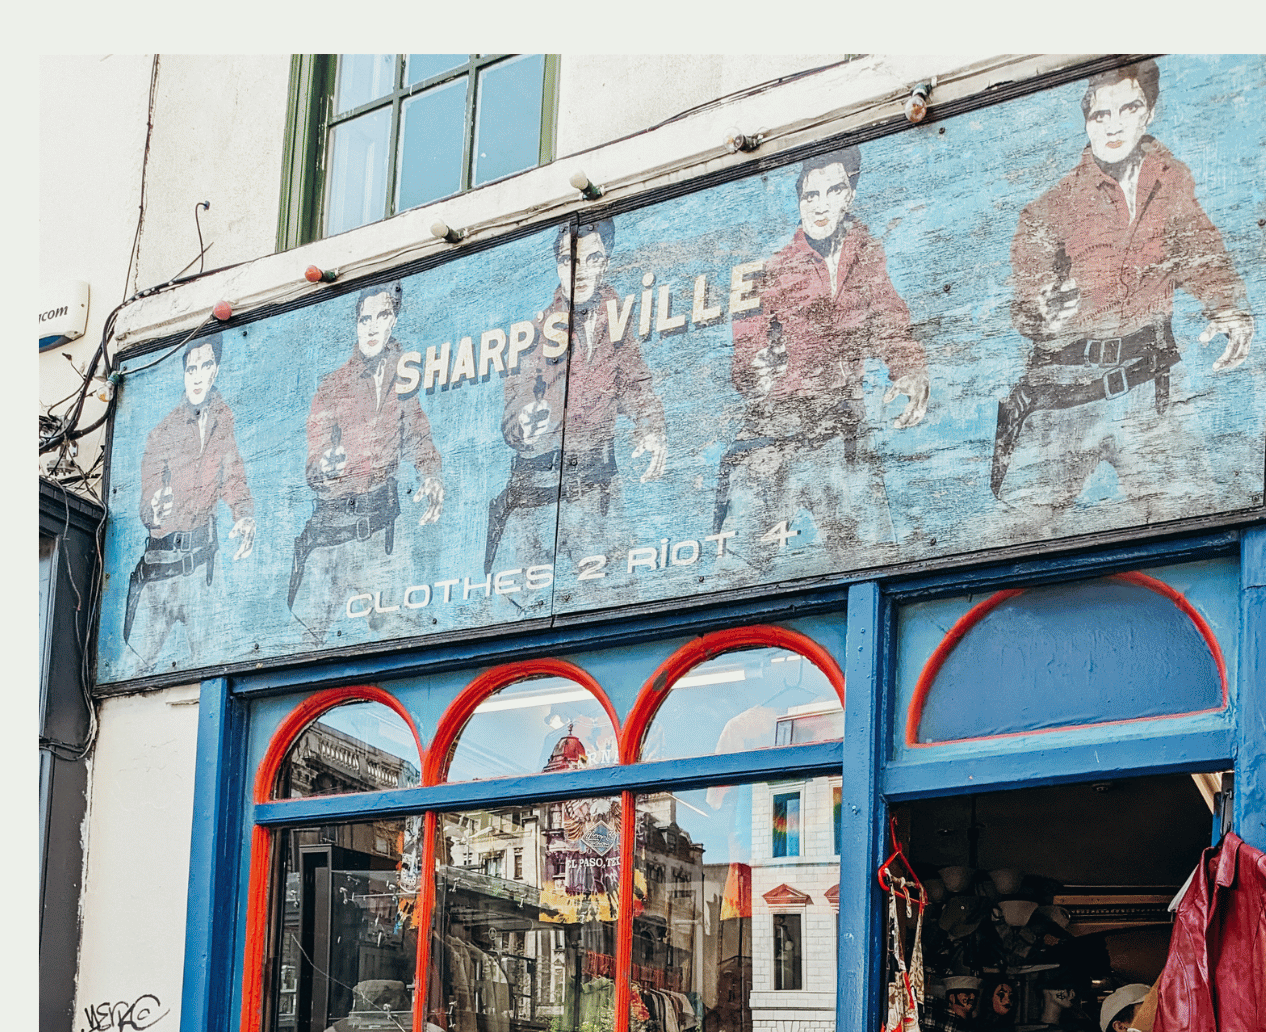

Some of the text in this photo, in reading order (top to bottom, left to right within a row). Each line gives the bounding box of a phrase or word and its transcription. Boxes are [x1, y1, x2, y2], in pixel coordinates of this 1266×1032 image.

[395, 310, 571, 396] SHARP'S
[345, 562, 554, 619] CLOTHES
[576, 554, 607, 583] 2
[760, 520, 801, 548] 4
